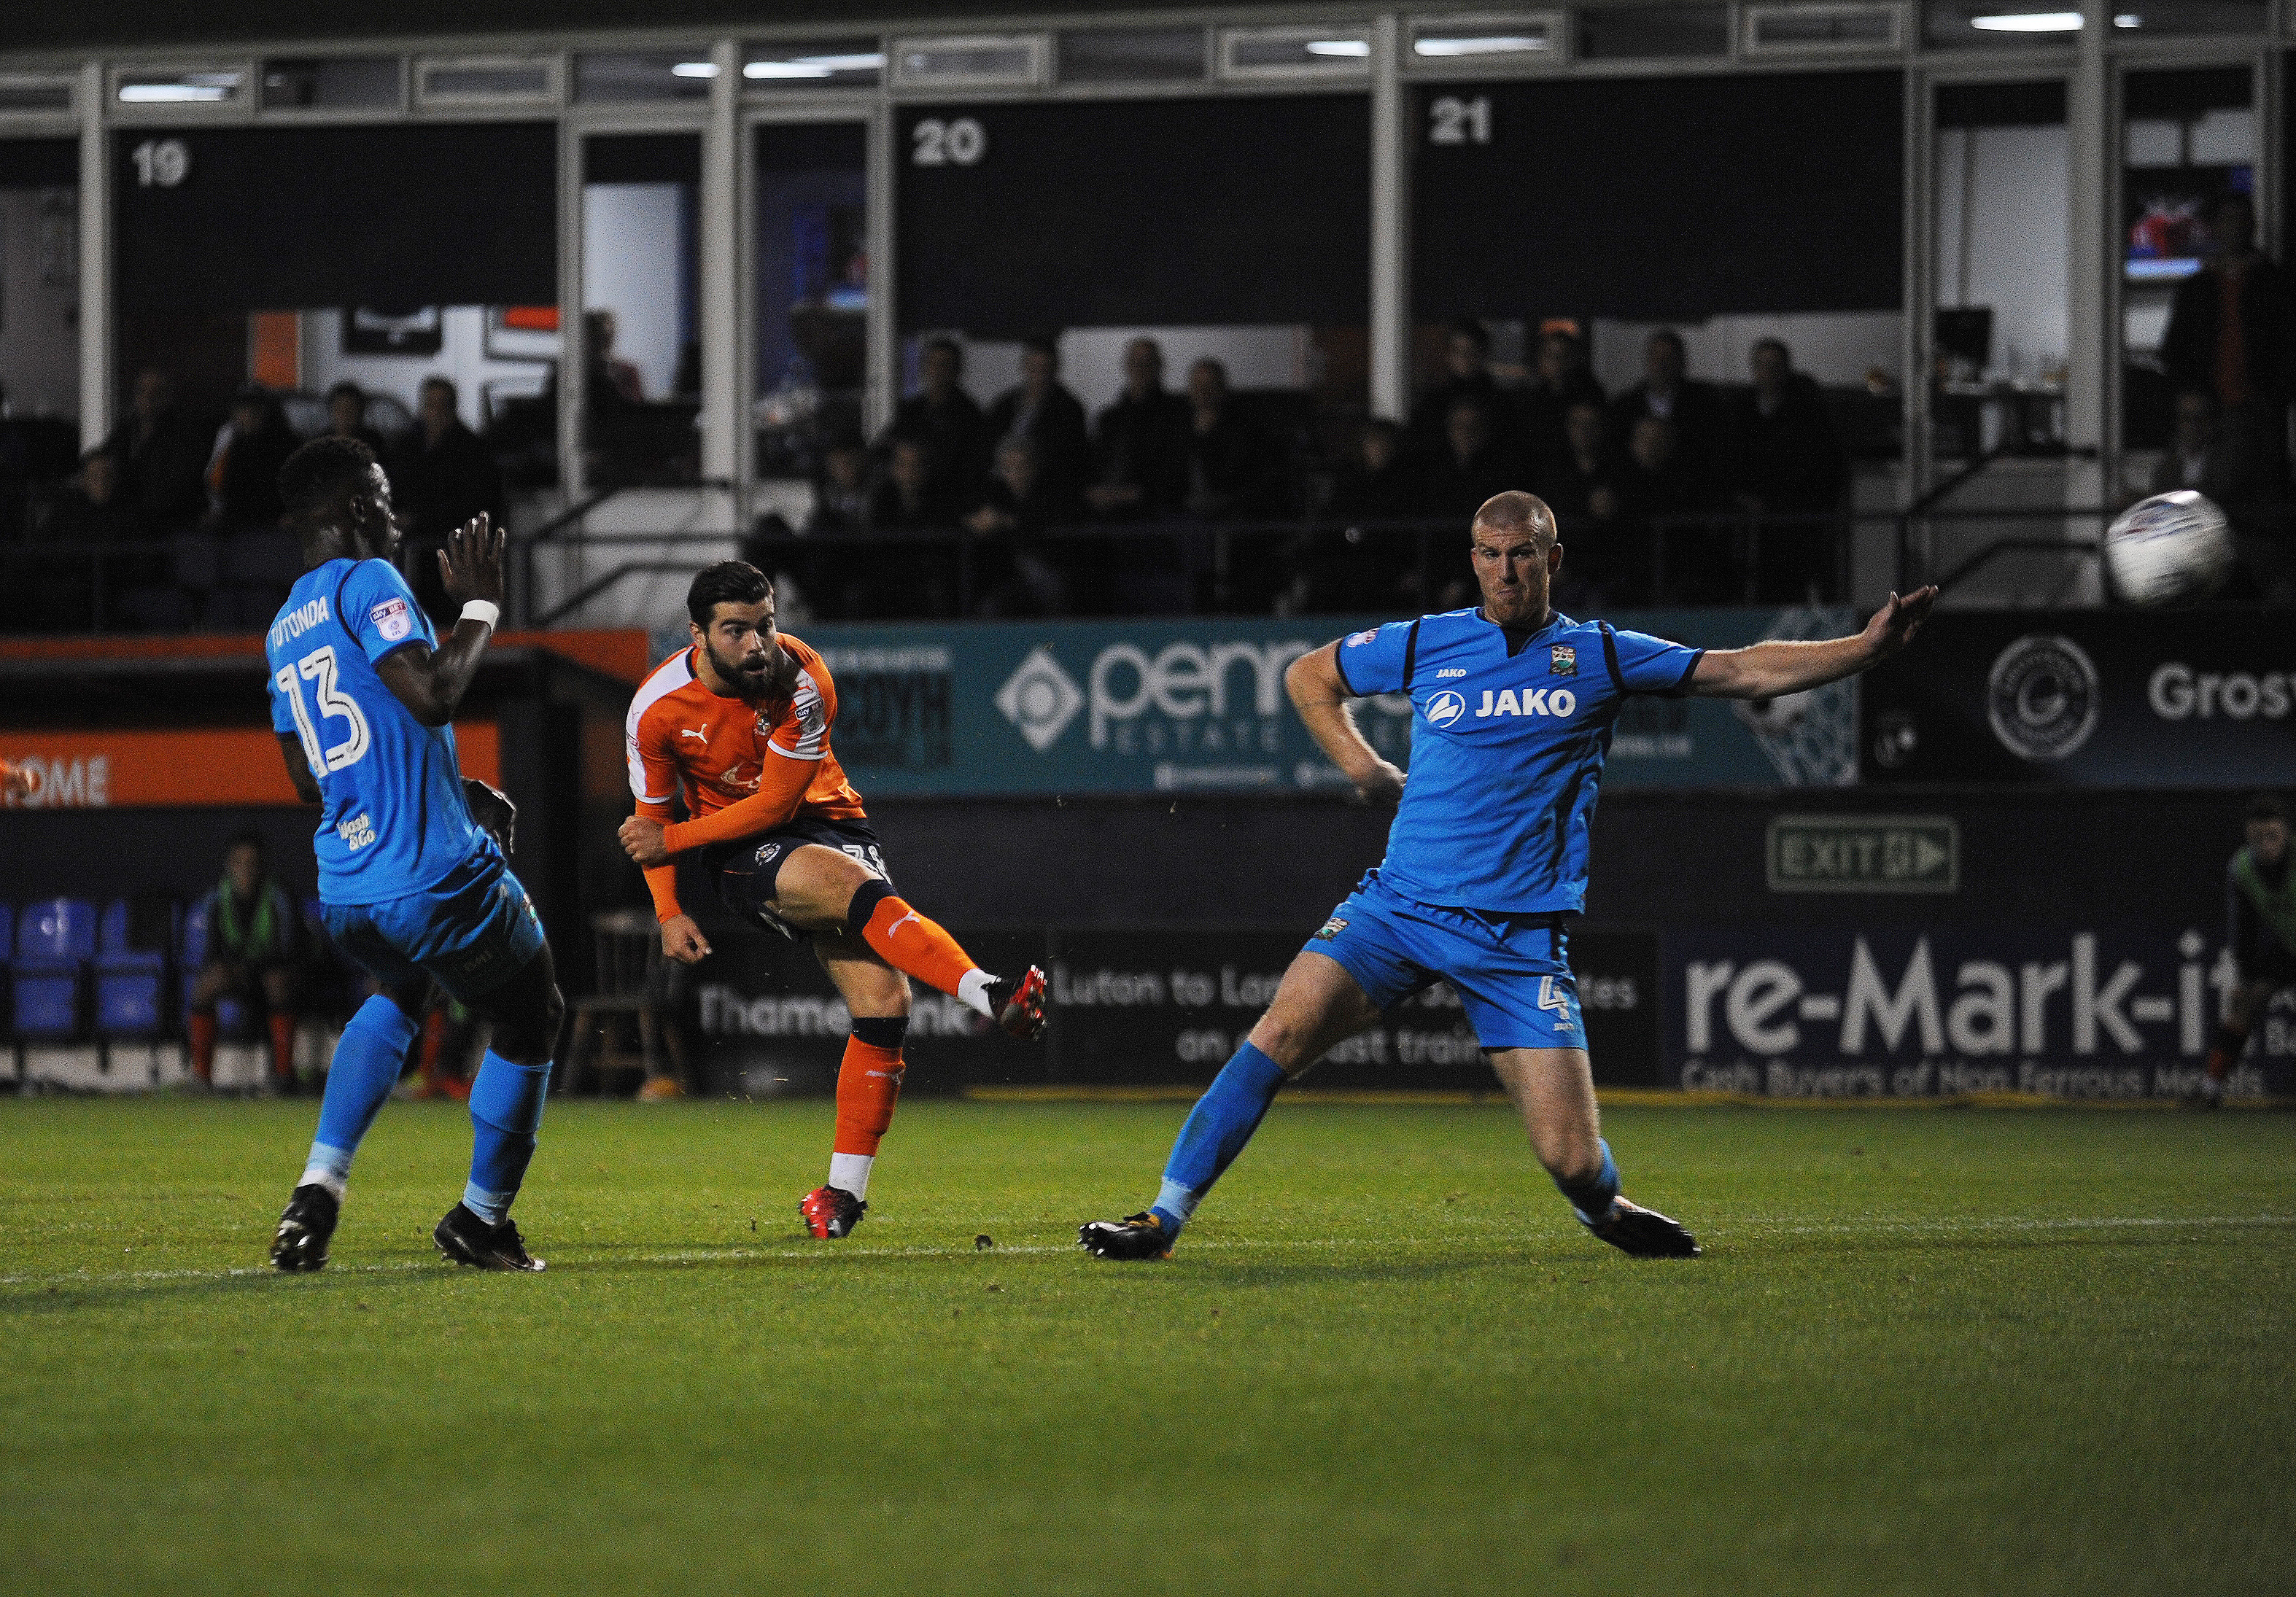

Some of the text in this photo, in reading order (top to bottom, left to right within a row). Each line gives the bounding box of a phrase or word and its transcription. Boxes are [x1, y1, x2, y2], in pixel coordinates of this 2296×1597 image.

[912, 117, 985, 166] 20
[1430, 96, 1490, 144] 21
[132, 140, 188, 187] 19
[1436, 668, 1467, 678] JAKO
[276, 645, 370, 779] 13
[1475, 688, 1577, 718] JAKO
[1117, 723, 1281, 754] ESTATE
[9, 754, 109, 808] OME
[1782, 835, 1877, 876] EXIT
[1052, 963, 1163, 1006] Luton
[1171, 970, 1214, 1006] to
[1537, 976, 1570, 1019] 4
[1176, 1028, 1229, 1062] on
[1325, 1029, 1387, 1065] ast
[1682, 1060, 1756, 1093] Cash
[1767, 1060, 1882, 1097] Buyers
[1893, 1060, 1933, 1095] of
[1941, 1062, 2007, 1095] Non
